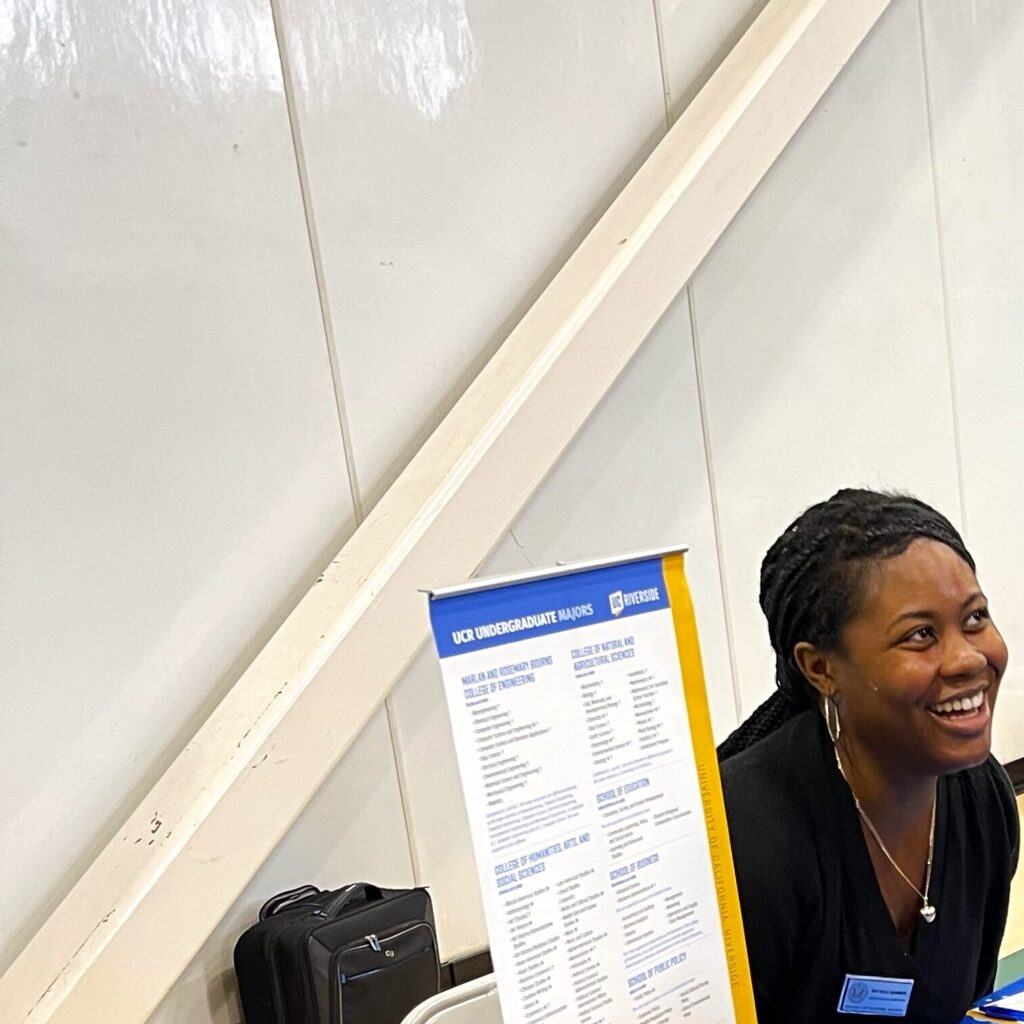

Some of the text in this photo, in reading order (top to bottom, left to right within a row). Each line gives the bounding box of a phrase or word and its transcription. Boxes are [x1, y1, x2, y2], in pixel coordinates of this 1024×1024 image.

[623, 588, 660, 607] RIVERSIDE
[452, 603, 594, 645] UCR UNDERGRADUATE MAJORS
